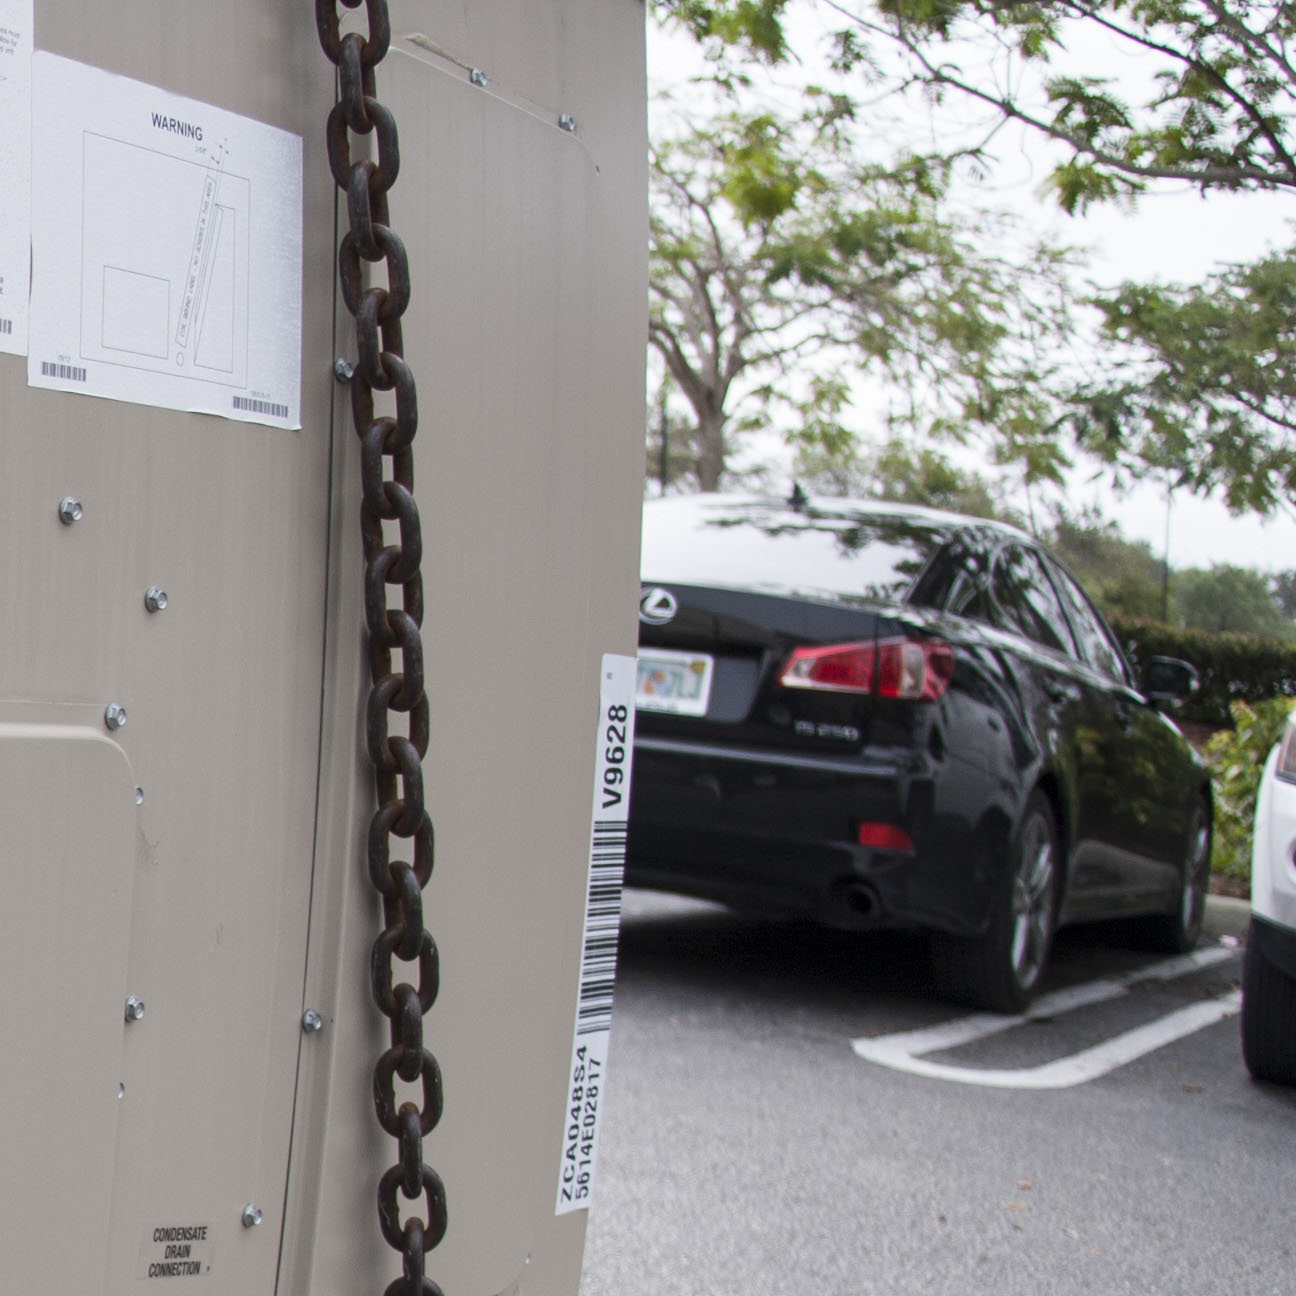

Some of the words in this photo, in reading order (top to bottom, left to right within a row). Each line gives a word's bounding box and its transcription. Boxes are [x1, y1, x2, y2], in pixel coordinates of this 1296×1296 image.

[151, 110, 204, 142] WARNING
[601, 704, 628, 809] V9628
[559, 1044, 588, 1203] ZCA048S4
[575, 1057, 601, 1200] 5614E02817
[152, 1226, 208, 1242] CONDENSATE
[164, 1244, 192, 1259] DRAIN
[148, 1261, 202, 1278] CONNECTION
